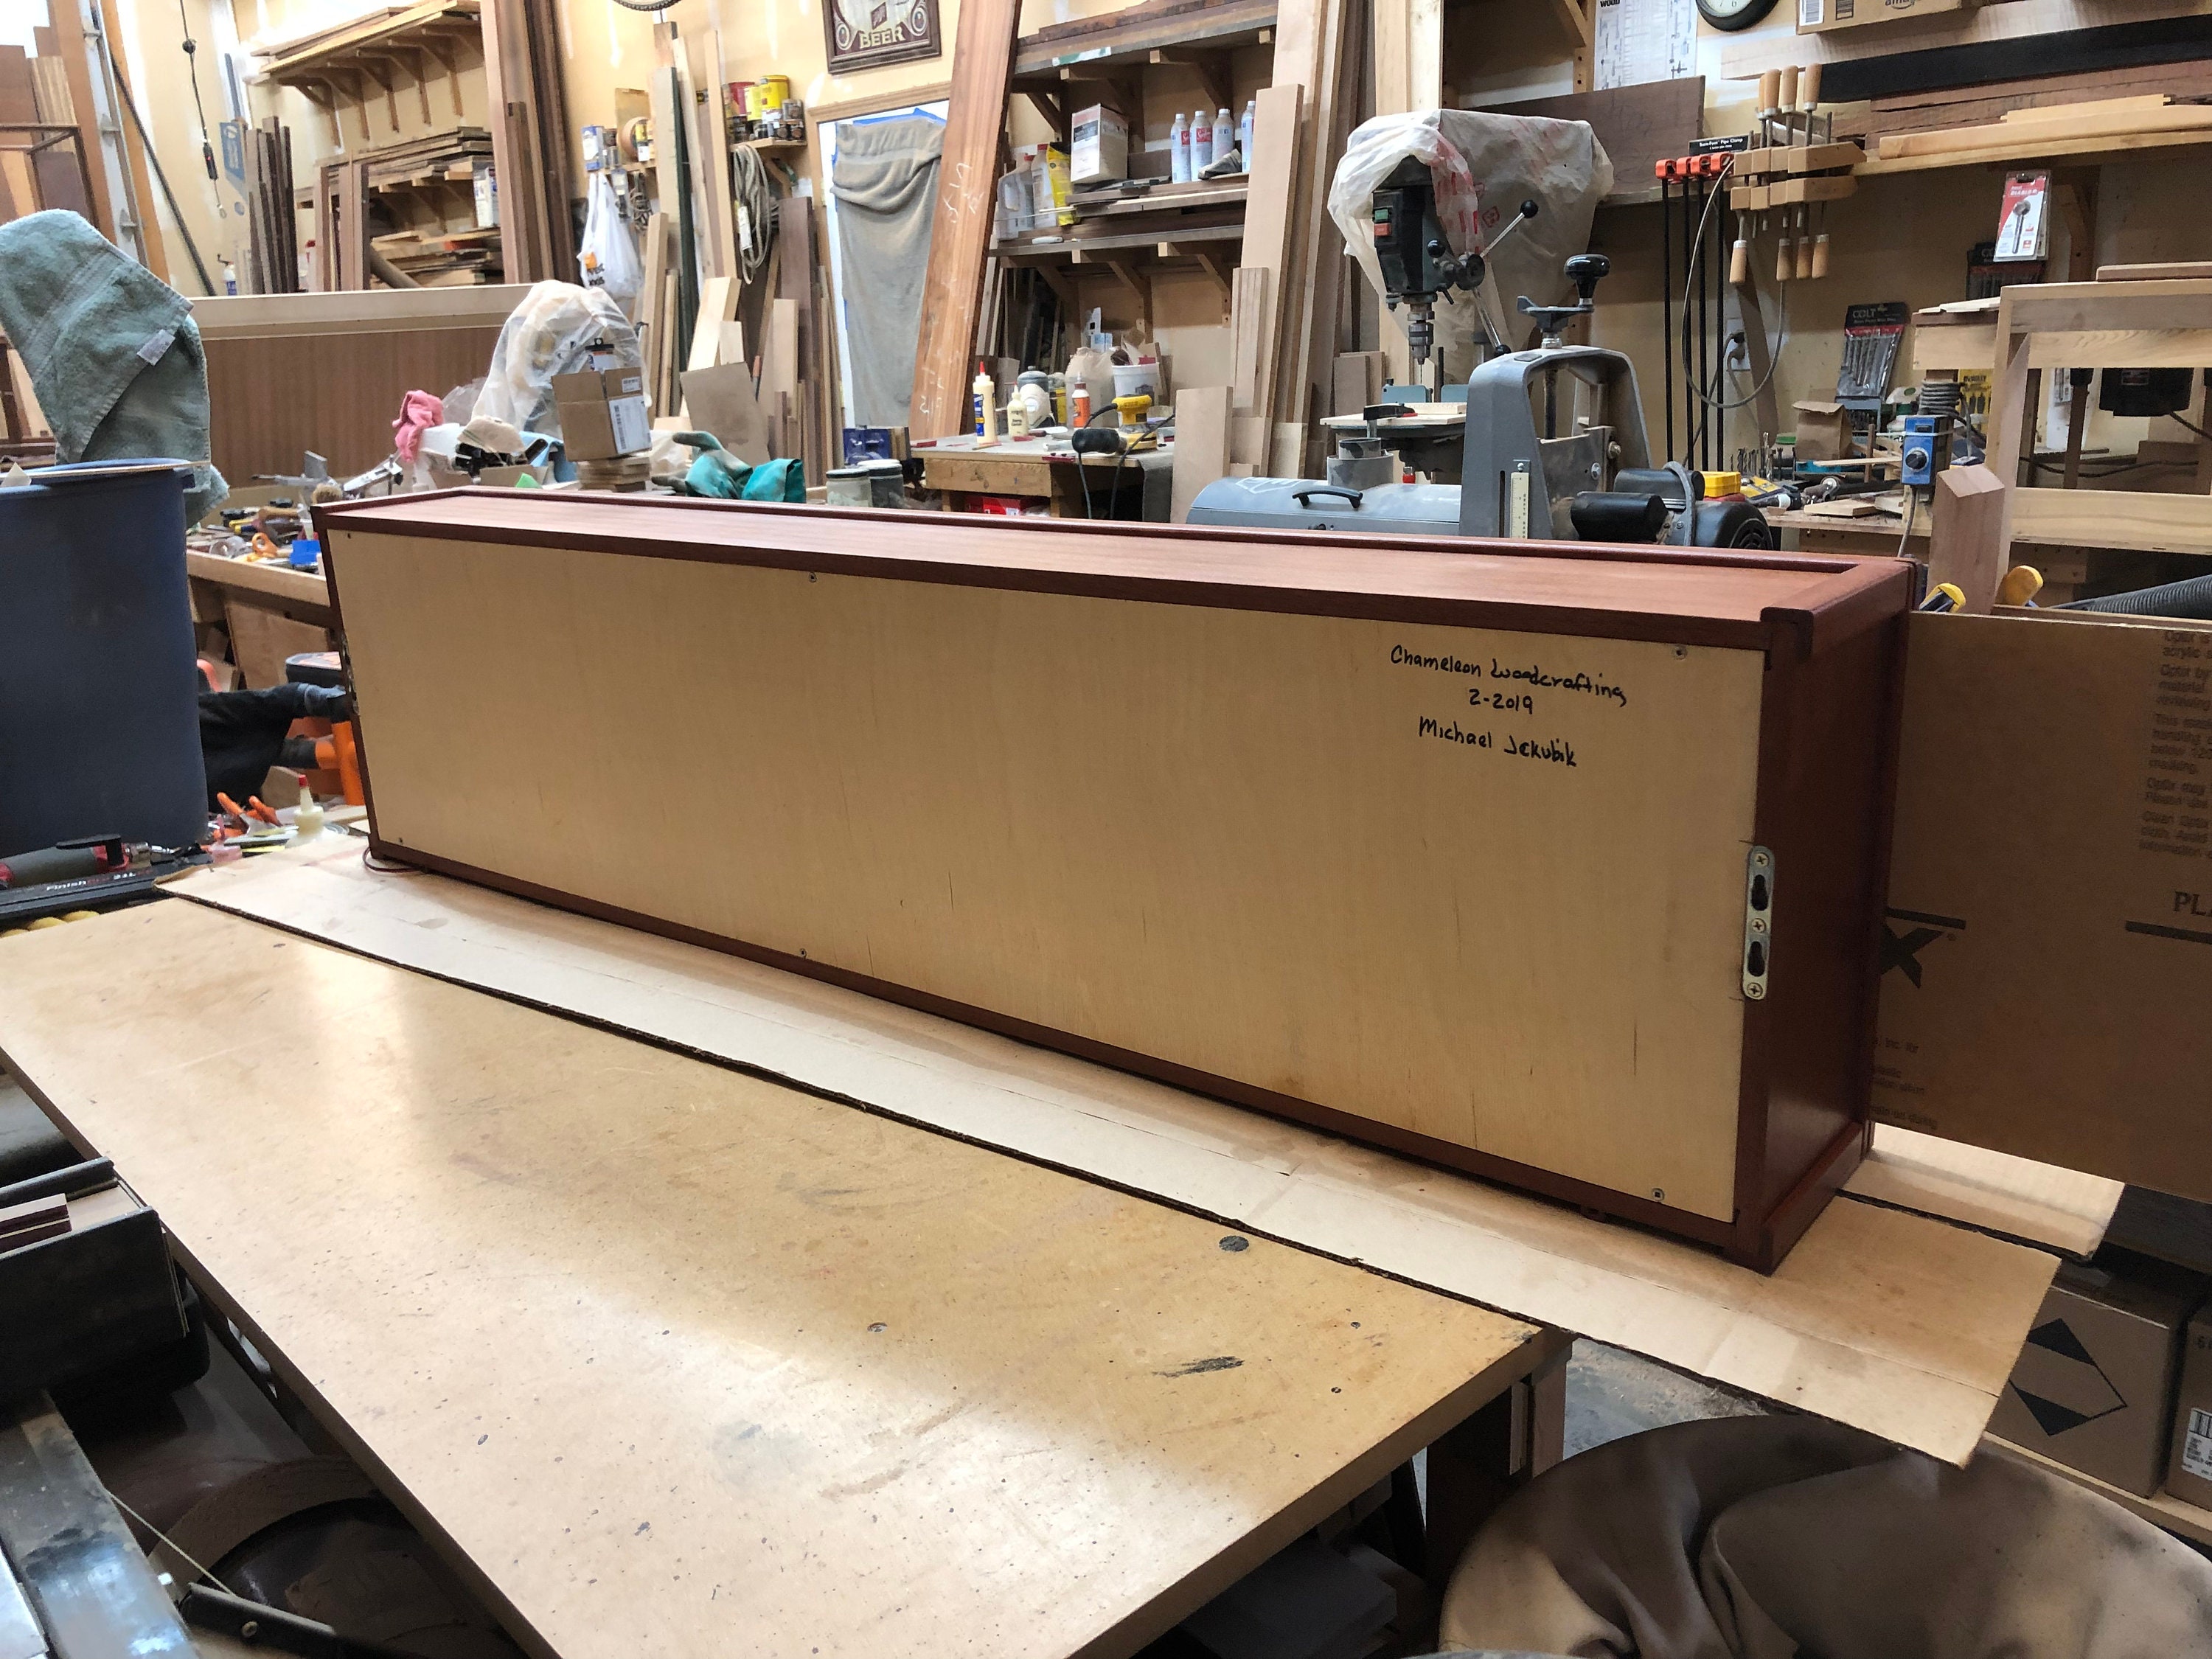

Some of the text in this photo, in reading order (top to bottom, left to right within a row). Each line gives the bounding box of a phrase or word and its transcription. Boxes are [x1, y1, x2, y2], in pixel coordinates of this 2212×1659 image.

[860, 26, 906, 49] BEER
[1852, 308, 1877, 319] COLT
[1391, 644, 1627, 708] Chameleon Woodcrafting
[1469, 688, 1534, 715] 2-2019
[1419, 715, 1492, 749] Michael
[2173, 891, 2212, 918] PL
